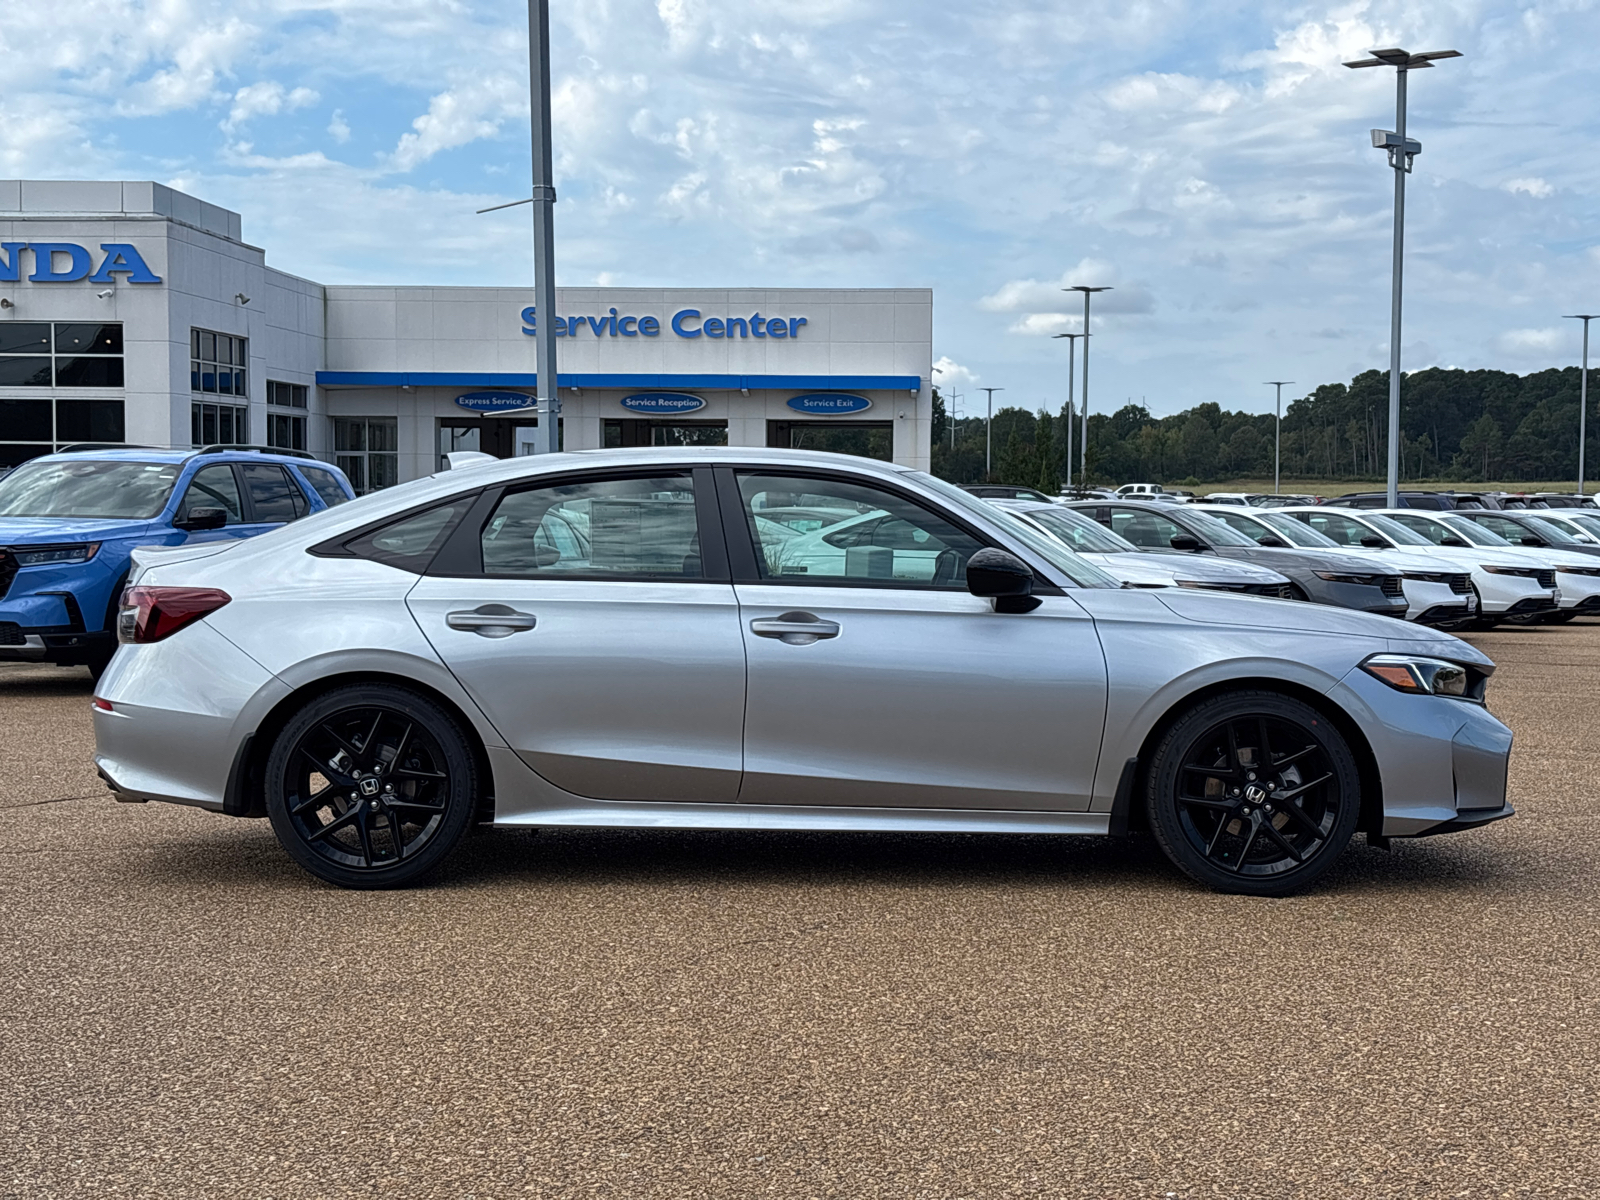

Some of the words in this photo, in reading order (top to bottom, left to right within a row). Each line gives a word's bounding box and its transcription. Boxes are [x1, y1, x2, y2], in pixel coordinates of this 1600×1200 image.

[671, 309, 807, 338] Center
[458, 396, 490, 406] Express
[491, 397, 522, 405] Service
[625, 398, 657, 406] Service
[658, 398, 700, 408] Reception
[803, 398, 835, 407] Service
[836, 398, 854, 407] Exit
